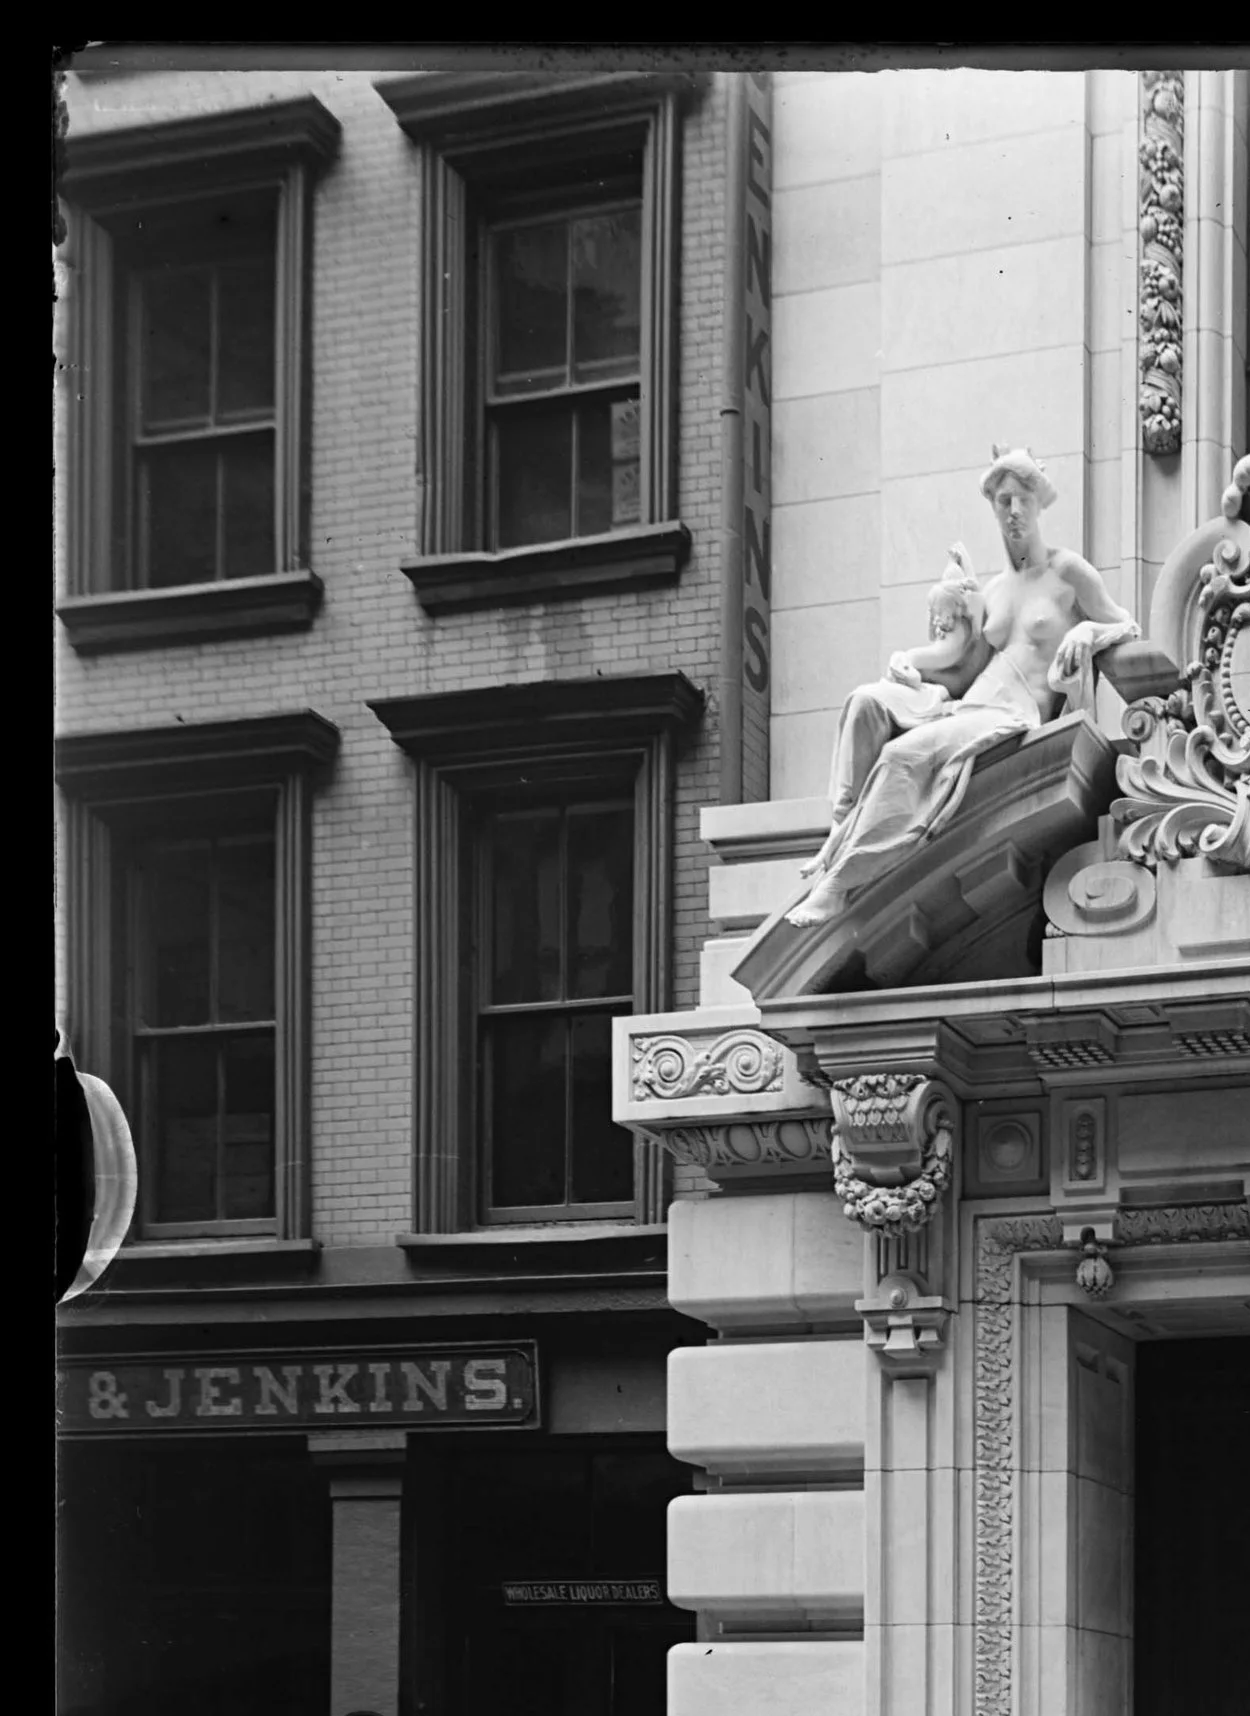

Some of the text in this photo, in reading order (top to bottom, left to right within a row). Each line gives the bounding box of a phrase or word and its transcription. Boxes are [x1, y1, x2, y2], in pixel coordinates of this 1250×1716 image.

[88, 1370, 129, 1419] &
[507, 1584, 660, 1602] WHOLESALE LIQUOR DEALERS
